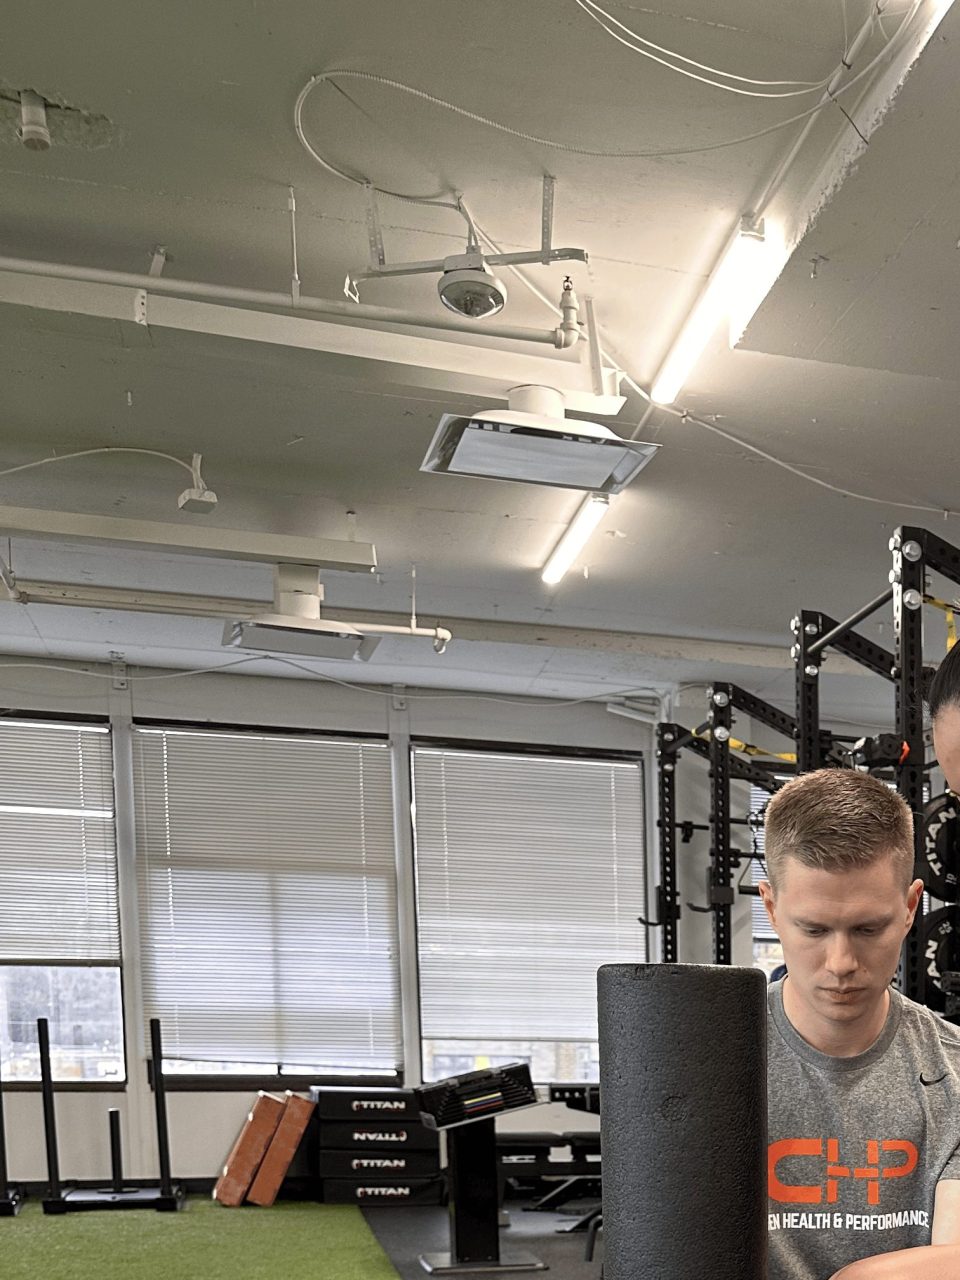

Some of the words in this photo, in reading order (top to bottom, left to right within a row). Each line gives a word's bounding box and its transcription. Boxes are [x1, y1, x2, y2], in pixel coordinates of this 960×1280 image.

[925, 807, 956, 876] TITAN
[360, 1101, 406, 1109] TITAN
[353, 1132, 400, 1141] TITAN
[360, 1159, 406, 1168] TITAN
[768, 1138, 919, 1205] CHP
[365, 1187, 410, 1195] TITAN
[783, 1213, 831, 1229] HEALTH
[833, 1213, 843, 1228] &
[846, 1210, 930, 1230] PERFORMANCE
